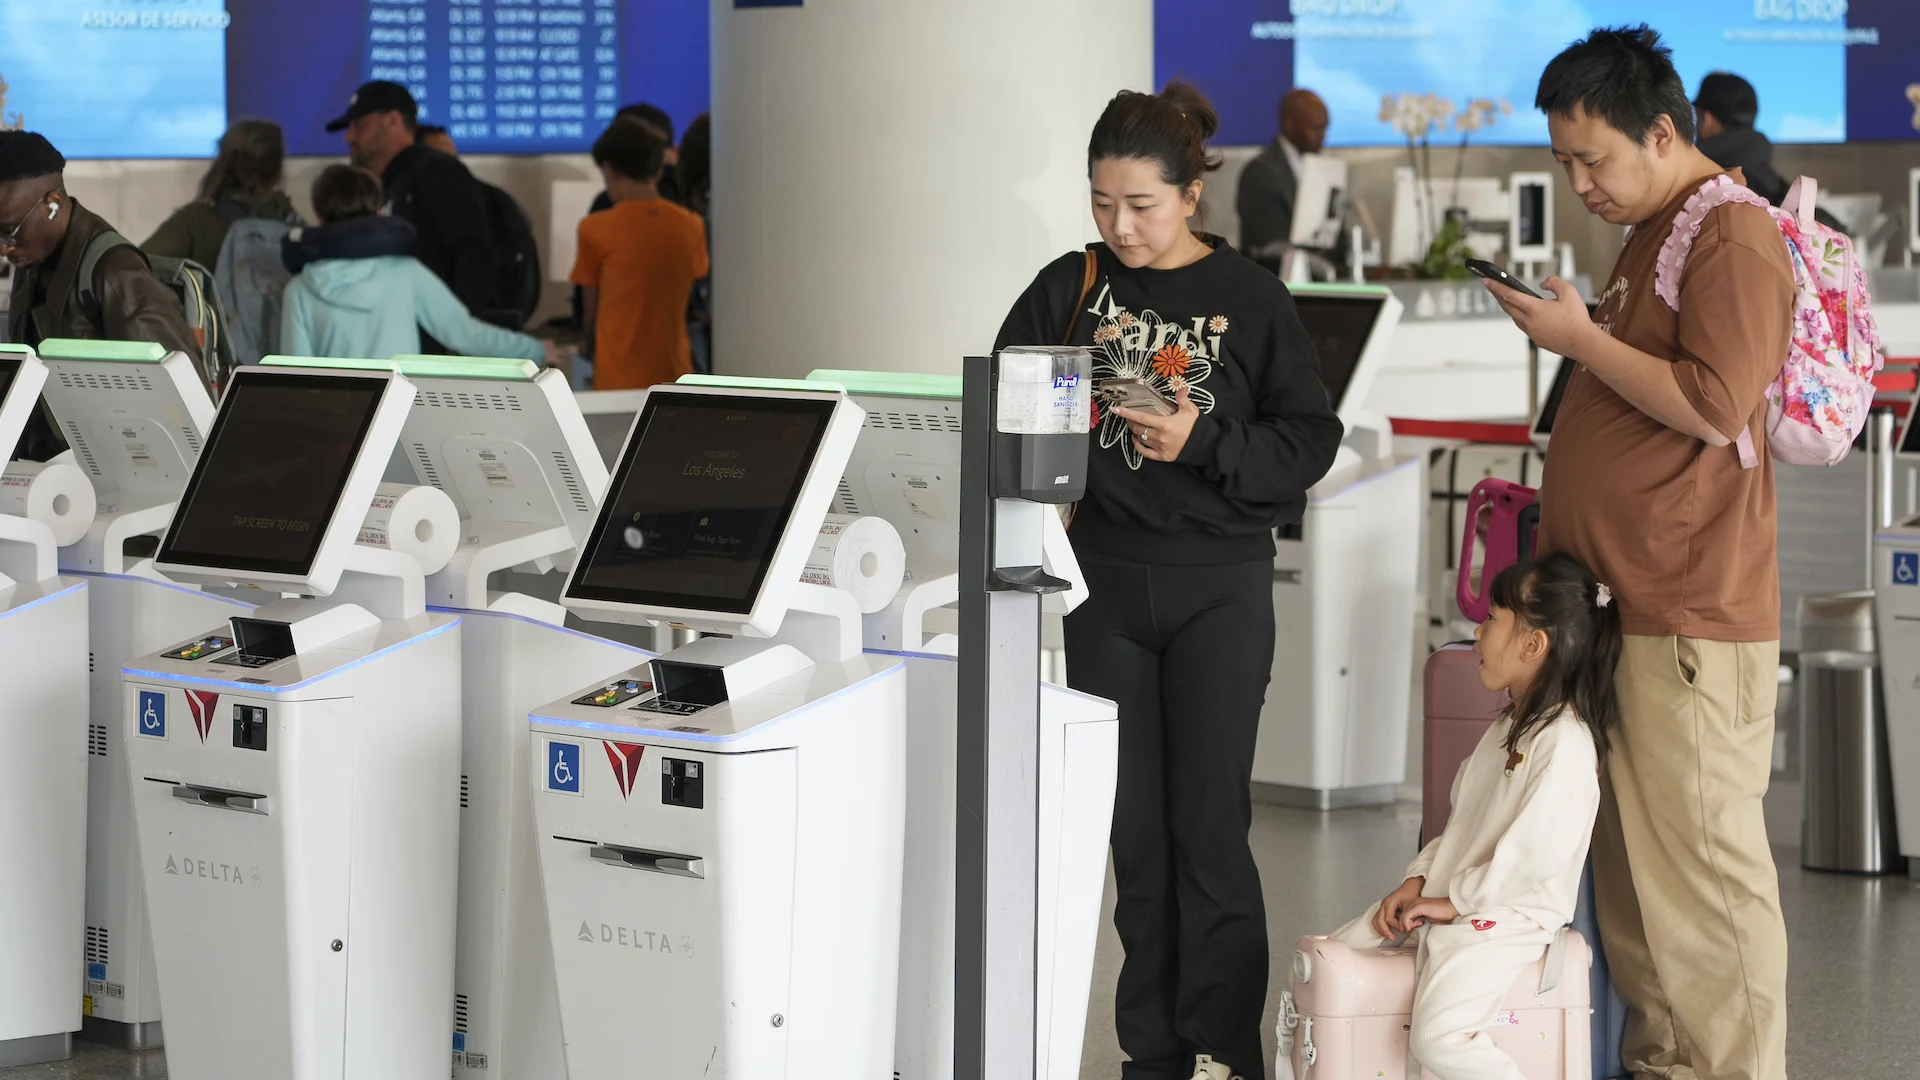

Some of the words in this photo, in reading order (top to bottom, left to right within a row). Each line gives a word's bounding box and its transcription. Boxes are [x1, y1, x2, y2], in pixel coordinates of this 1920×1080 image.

[1796, 0, 1848, 21] DROP
[82, 10, 138, 28] ASESOR
[140, 10, 160, 28] DE
[163, 10, 232, 28] SERVICIO
[539, 28, 580, 44] CLOSED
[553, 47, 580, 63] GATE
[558, 66, 584, 82] TIME
[558, 86, 584, 102] TIME
[559, 124, 584, 139] TIME
[683, 461, 701, 477] Los
[702, 463, 746, 480] Angeles
[232, 515, 248, 527] TAP
[247, 516, 275, 529] SCREEN
[276, 518, 287, 530] TO
[287, 519, 311, 531] BEGIN
[183, 857, 243, 884] DELTA
[600, 923, 672, 953] DELTA
